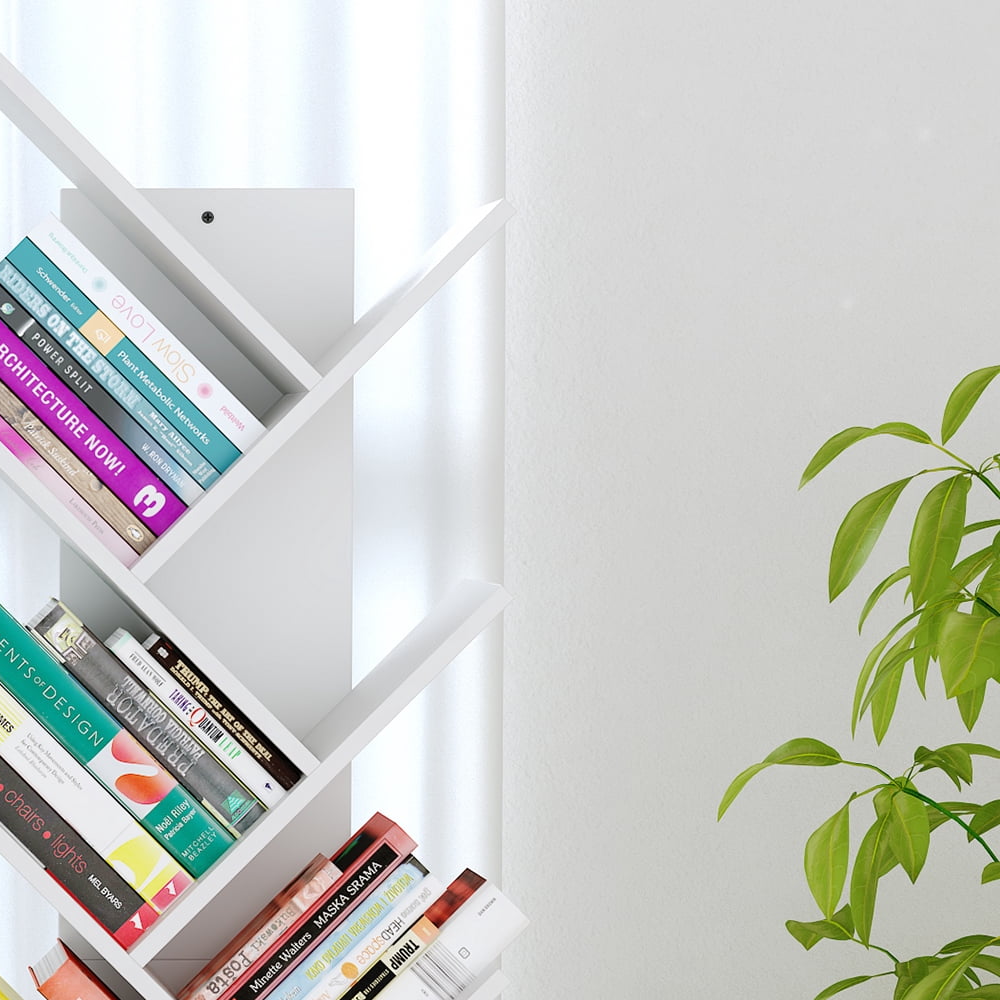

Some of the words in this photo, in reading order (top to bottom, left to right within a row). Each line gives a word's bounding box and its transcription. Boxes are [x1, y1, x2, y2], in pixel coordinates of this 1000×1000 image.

[34, 266, 72, 303] Schwender
[105, 292, 156, 343] Love
[30, 332, 64, 366] POWER
[62, 364, 93, 395] SPLIT
[44, 312, 71, 338] ON
[63, 330, 97, 365] THE
[89, 358, 142, 410] STORM
[146, 335, 197, 385] Slow
[116, 350, 140, 373] Plant
[135, 370, 177, 410] Metabolic
[172, 406, 212, 445] Networks
[147, 411, 170, 433] Mary
[83, 433, 126, 476] NOW!
[147, 450, 163, 465] RON
[32, 674, 46, 689] OF
[39, 683, 106, 747] DESIGN
[167, 688, 192, 712] TAKING
[172, 658, 212, 697] TRUMP:
[206, 694, 223, 710] THE
[218, 707, 235, 723] ART
[232, 720, 244, 732] OF
[241, 729, 258, 745] THE
[254, 742, 274, 761] DEAL
[103, 684, 198, 776] PREDATOR
[162, 718, 206, 760] PATRICIA
[163, 819, 184, 842] Patricia
[180, 806, 198, 825] Bayer
[169, 797, 192, 820] Riley
[1, 786, 48, 832] chairs
[47, 833, 92, 877] lights
[180, 823, 215, 859] MITCHELL
[187, 830, 218, 862] BEAZLEY
[86, 873, 104, 890] MEL
[99, 886, 123, 910] BYARS
[248, 959, 283, 993] Minette
[278, 929, 313, 963] Walters
[313, 892, 350, 928] MASKA
[344, 859, 383, 896] SRAMA
[248, 906, 296, 953] Bukowski
[204, 949, 253, 997] Pošta
[386, 937, 419, 970] TRUMP
